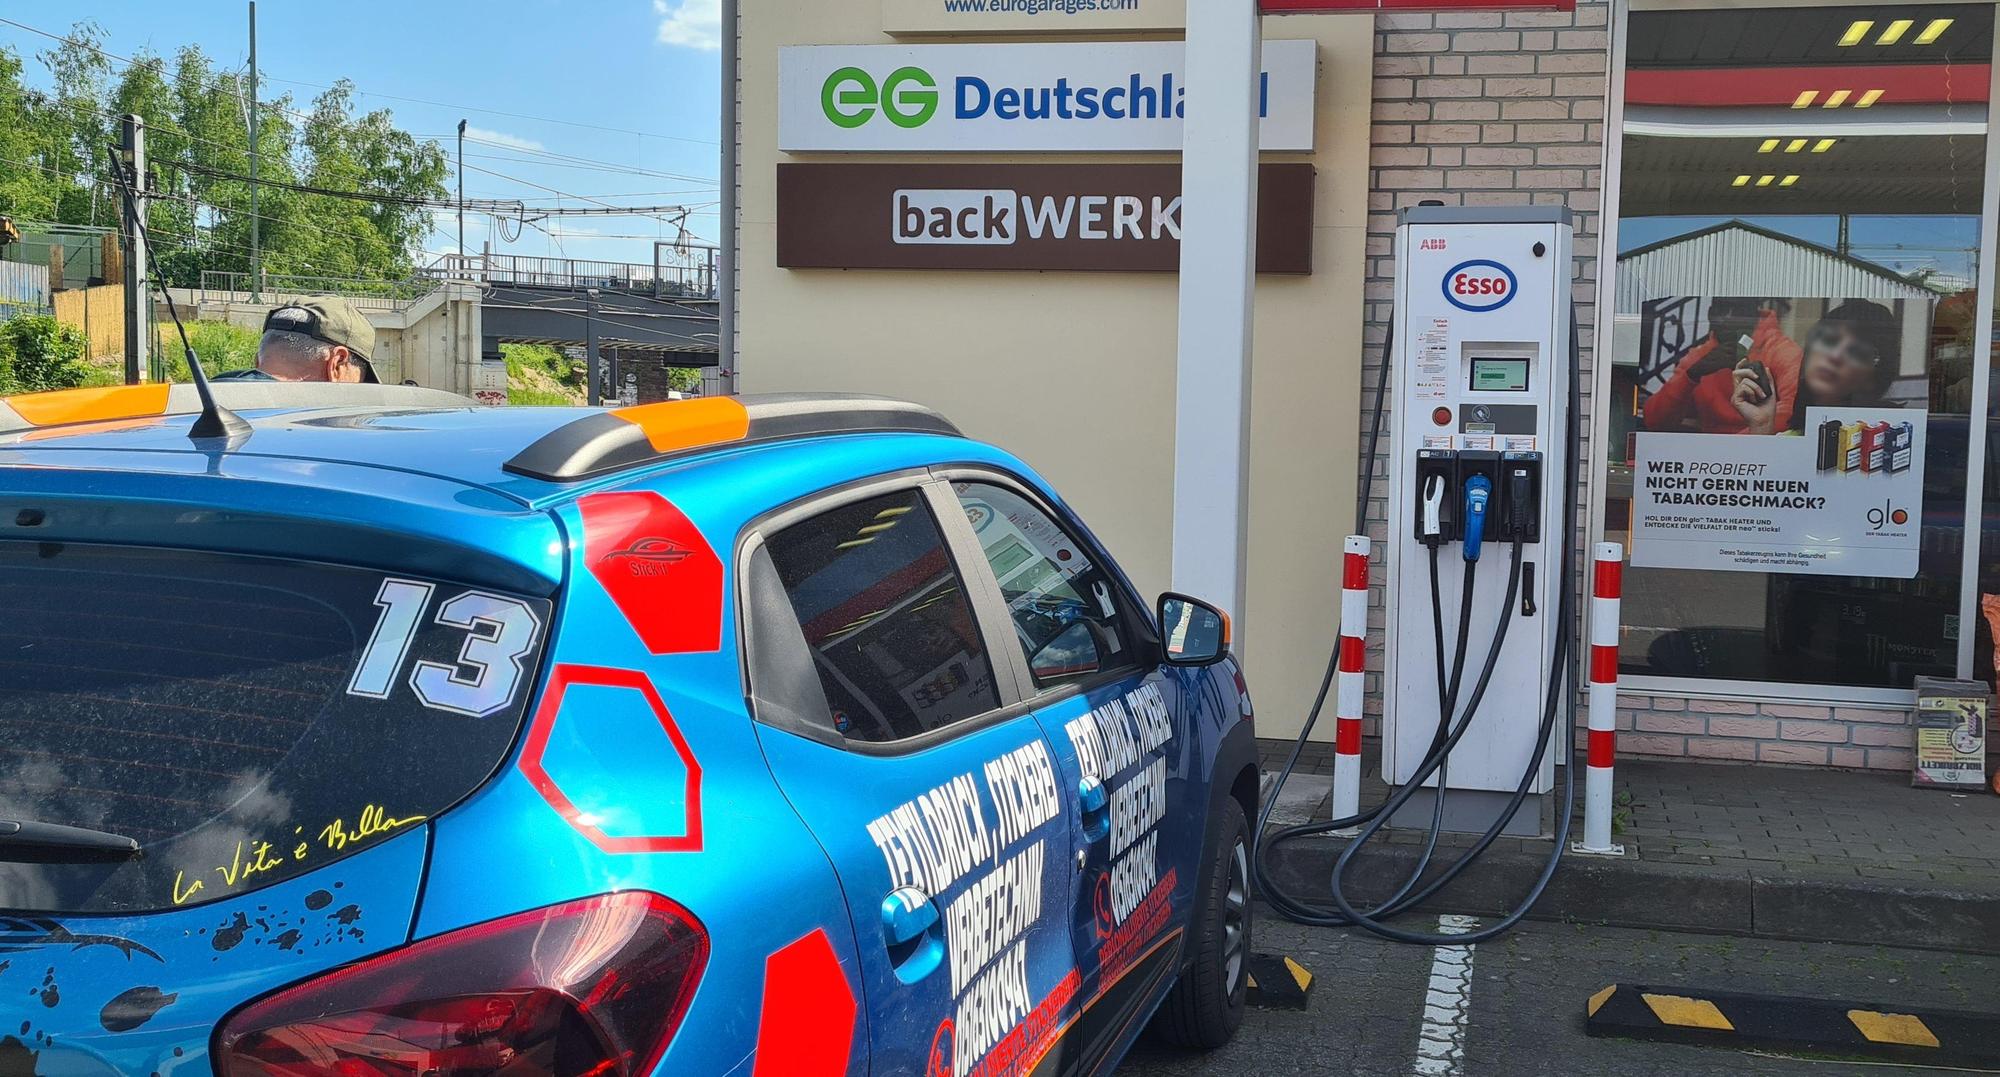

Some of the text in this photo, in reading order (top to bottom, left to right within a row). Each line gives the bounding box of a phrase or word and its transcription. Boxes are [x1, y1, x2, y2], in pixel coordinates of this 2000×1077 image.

[944, 0, 1138, 15] www.eurogarages.com
[955, 72, 1268, 120] Deutschl
[1420, 238, 1447, 250] ABB
[1648, 461, 1767, 476] WER PROBIERT
[1646, 477, 1809, 494] NICHT GERN NEUEN
[1652, 492, 1826, 510] TABAKGESCHMACK?
[631, 561, 657, 576] Stick
[346, 577, 540, 717] 13
[216, 840, 283, 885] Vita
[946, 838, 1044, 1000] WERBETECHNIK
